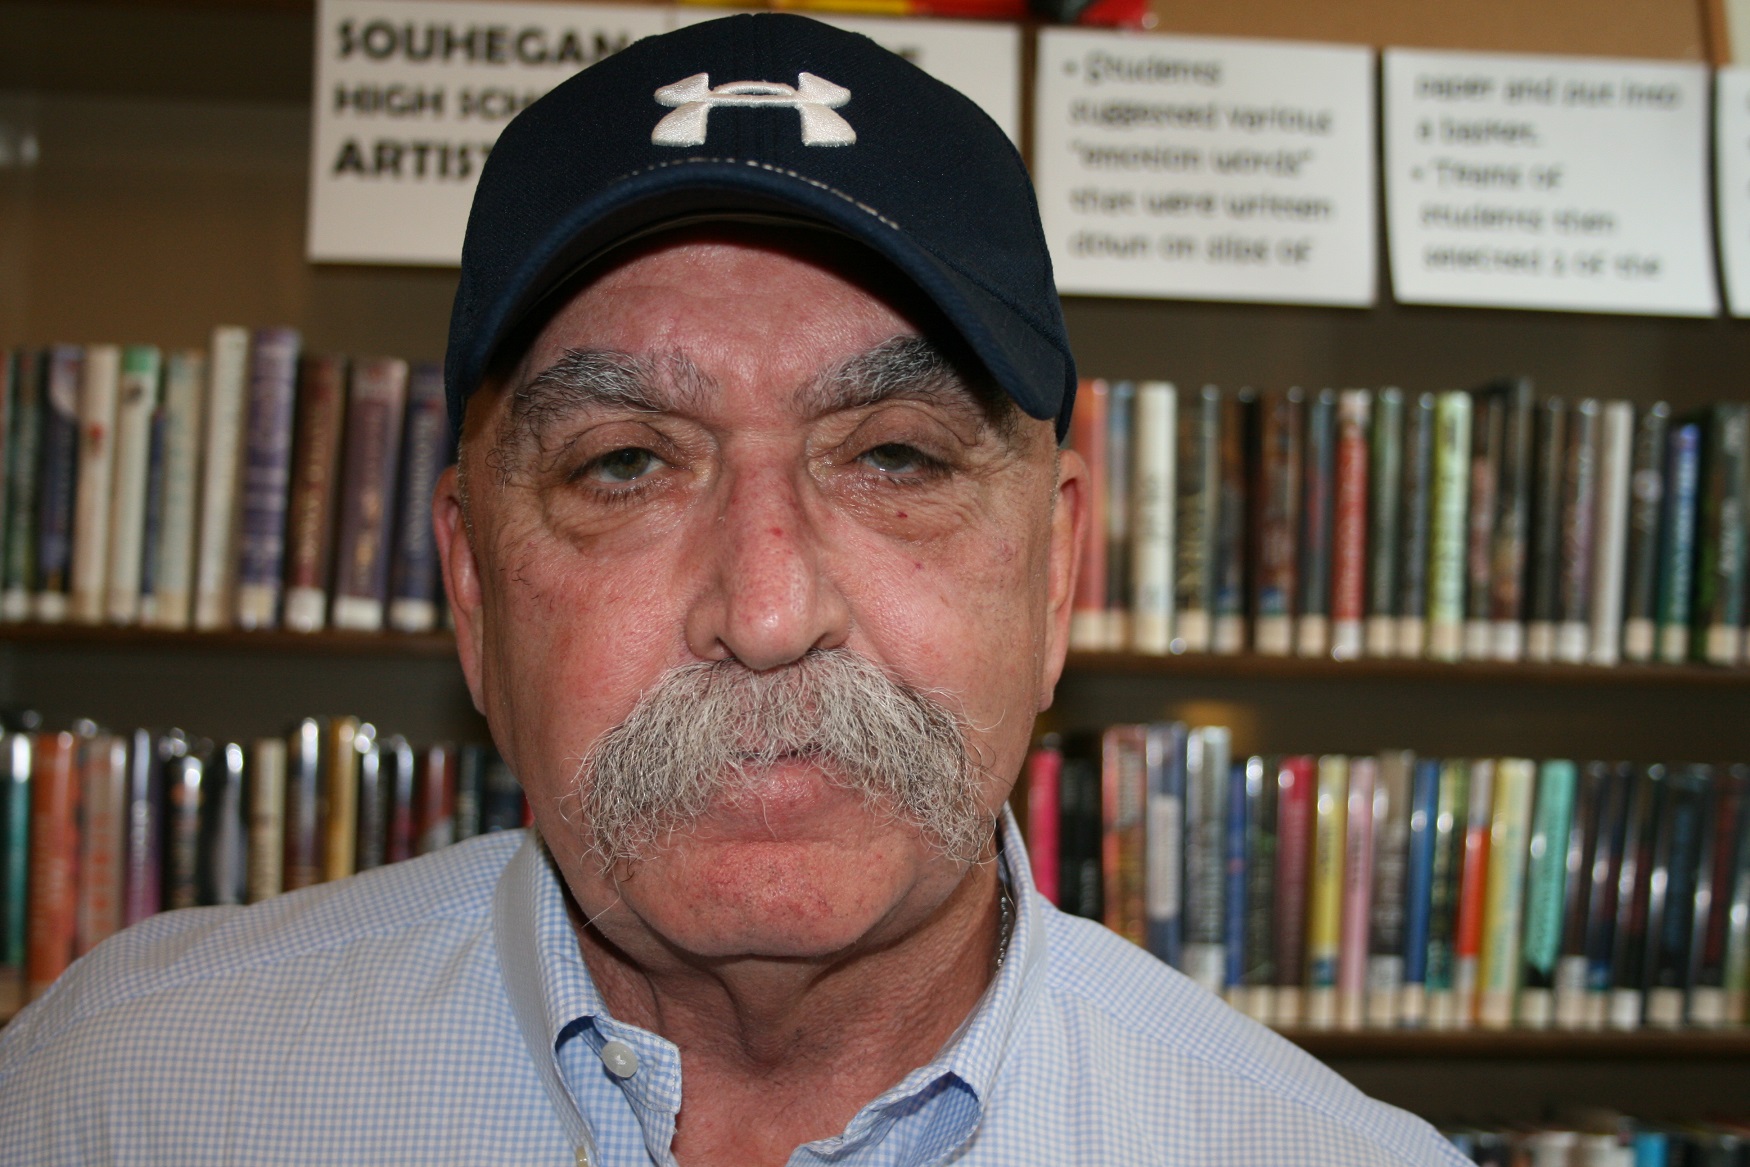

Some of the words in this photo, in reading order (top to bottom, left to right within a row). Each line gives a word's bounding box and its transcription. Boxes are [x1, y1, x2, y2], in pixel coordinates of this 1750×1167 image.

[340, 20, 634, 66] SOUHEGAN
[335, 84, 444, 116] HIGH
[1227, 108, 1333, 136] various
